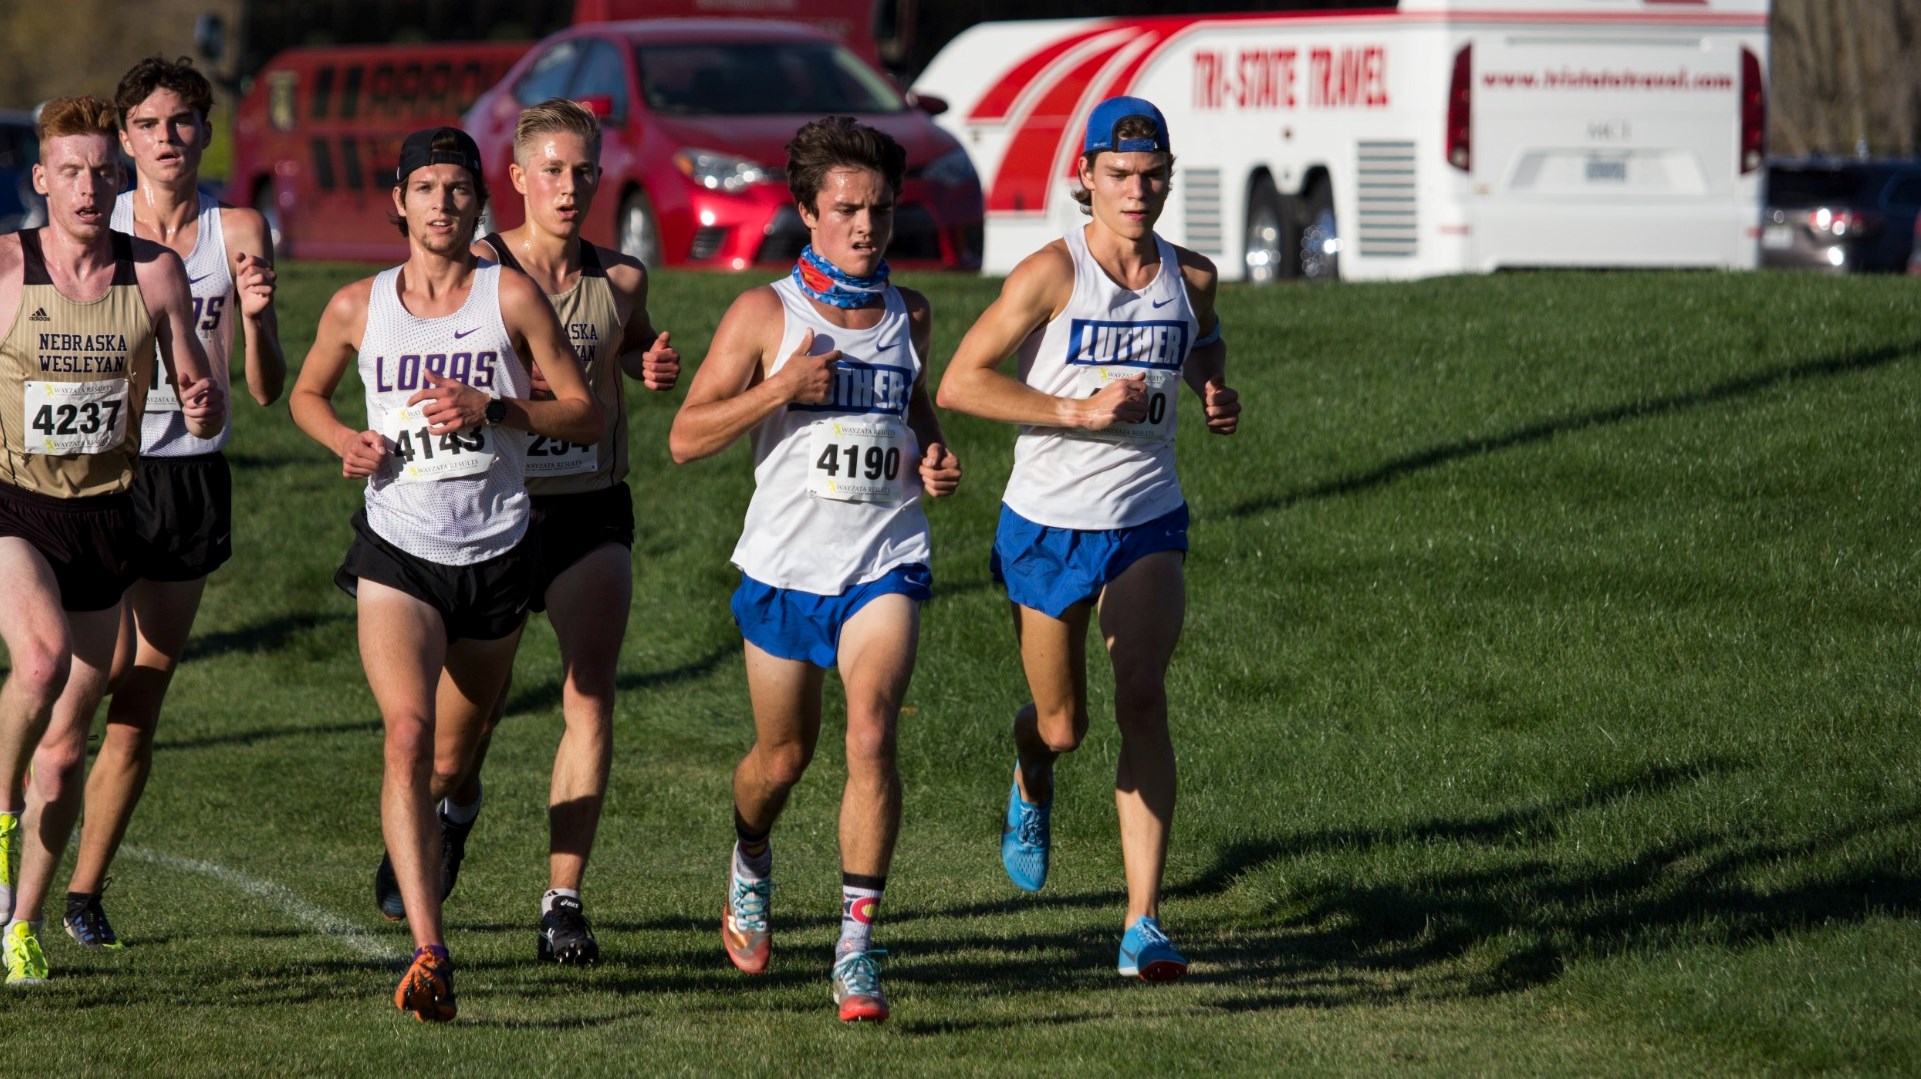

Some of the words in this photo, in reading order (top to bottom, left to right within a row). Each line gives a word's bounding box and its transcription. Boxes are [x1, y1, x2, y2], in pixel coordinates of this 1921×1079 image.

[1308, 46, 1389, 108] TRAVEL
[39, 333, 127, 351] NEBRASKA
[1077, 325, 1182, 364] LUTHER
[39, 355, 125, 373] WESLEYAN
[1107, 371, 1133, 379] WAYZAT
[835, 368, 905, 410] THER
[32, 400, 122, 436] 4237
[841, 427, 872, 435] WAYZATA
[394, 425, 485, 463] 4143
[417, 464, 448, 474] WAYZATA
[449, 459, 479, 469] RESULTS
[816, 444, 900, 481] 4190
[836, 484, 867, 492] WAYZATA
